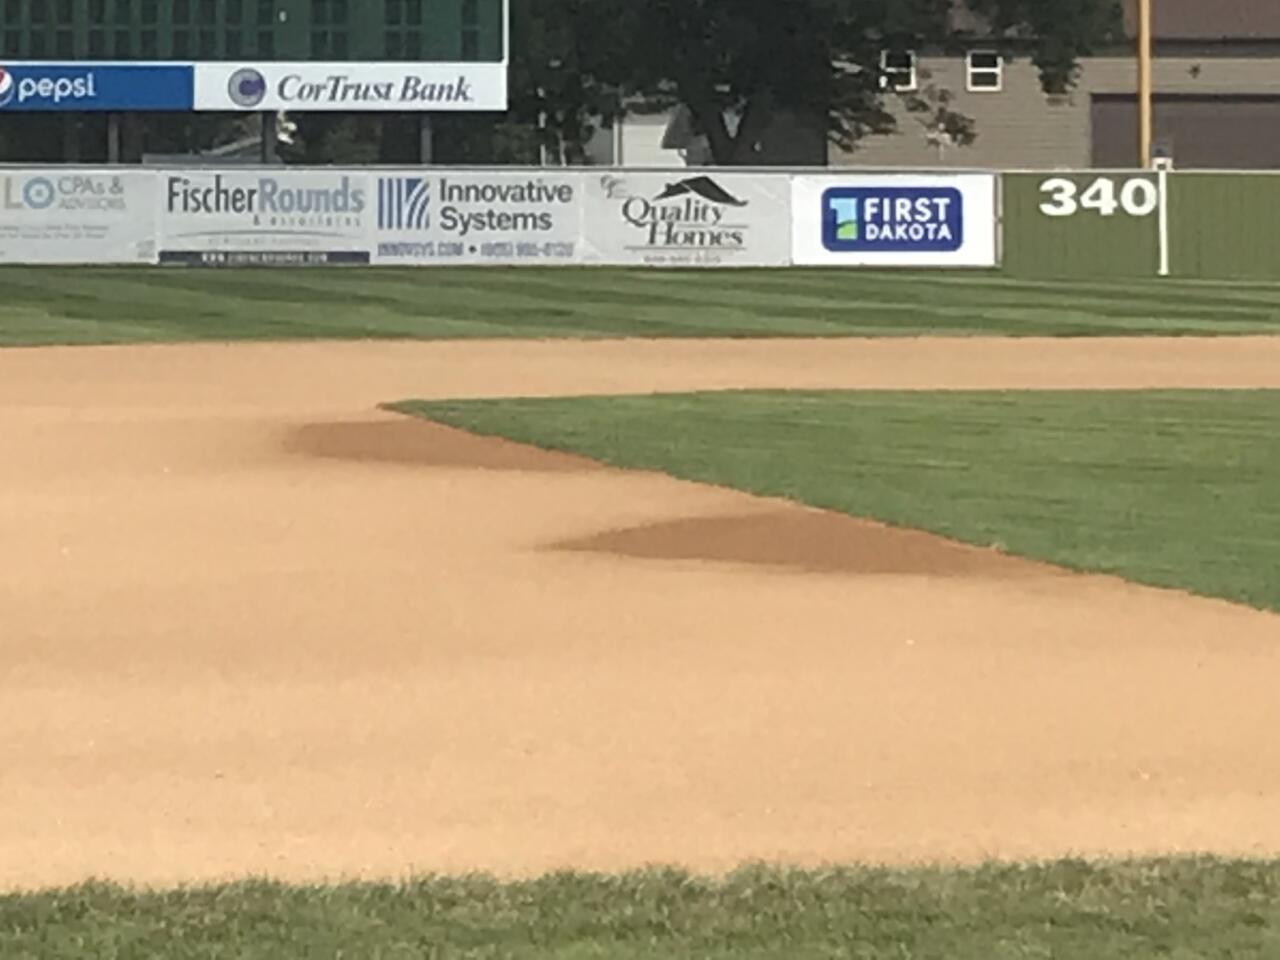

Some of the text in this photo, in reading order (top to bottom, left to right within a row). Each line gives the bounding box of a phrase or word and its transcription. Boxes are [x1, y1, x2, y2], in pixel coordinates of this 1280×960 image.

[18, 73, 97, 102] pepsi
[277, 75, 472, 102] CorTrust Bank
[58, 176, 105, 195] CPAs
[109, 176, 124, 194] &
[167, 174, 366, 214] FischerRounds
[439, 178, 573, 204] Innovative
[1038, 178, 1159, 216] 340
[439, 206, 553, 236] Systems
[621, 196, 724, 227] Quality
[864, 197, 951, 222] FIRST
[648, 221, 744, 246] Homes
[864, 222, 952, 241] DAKOTA
